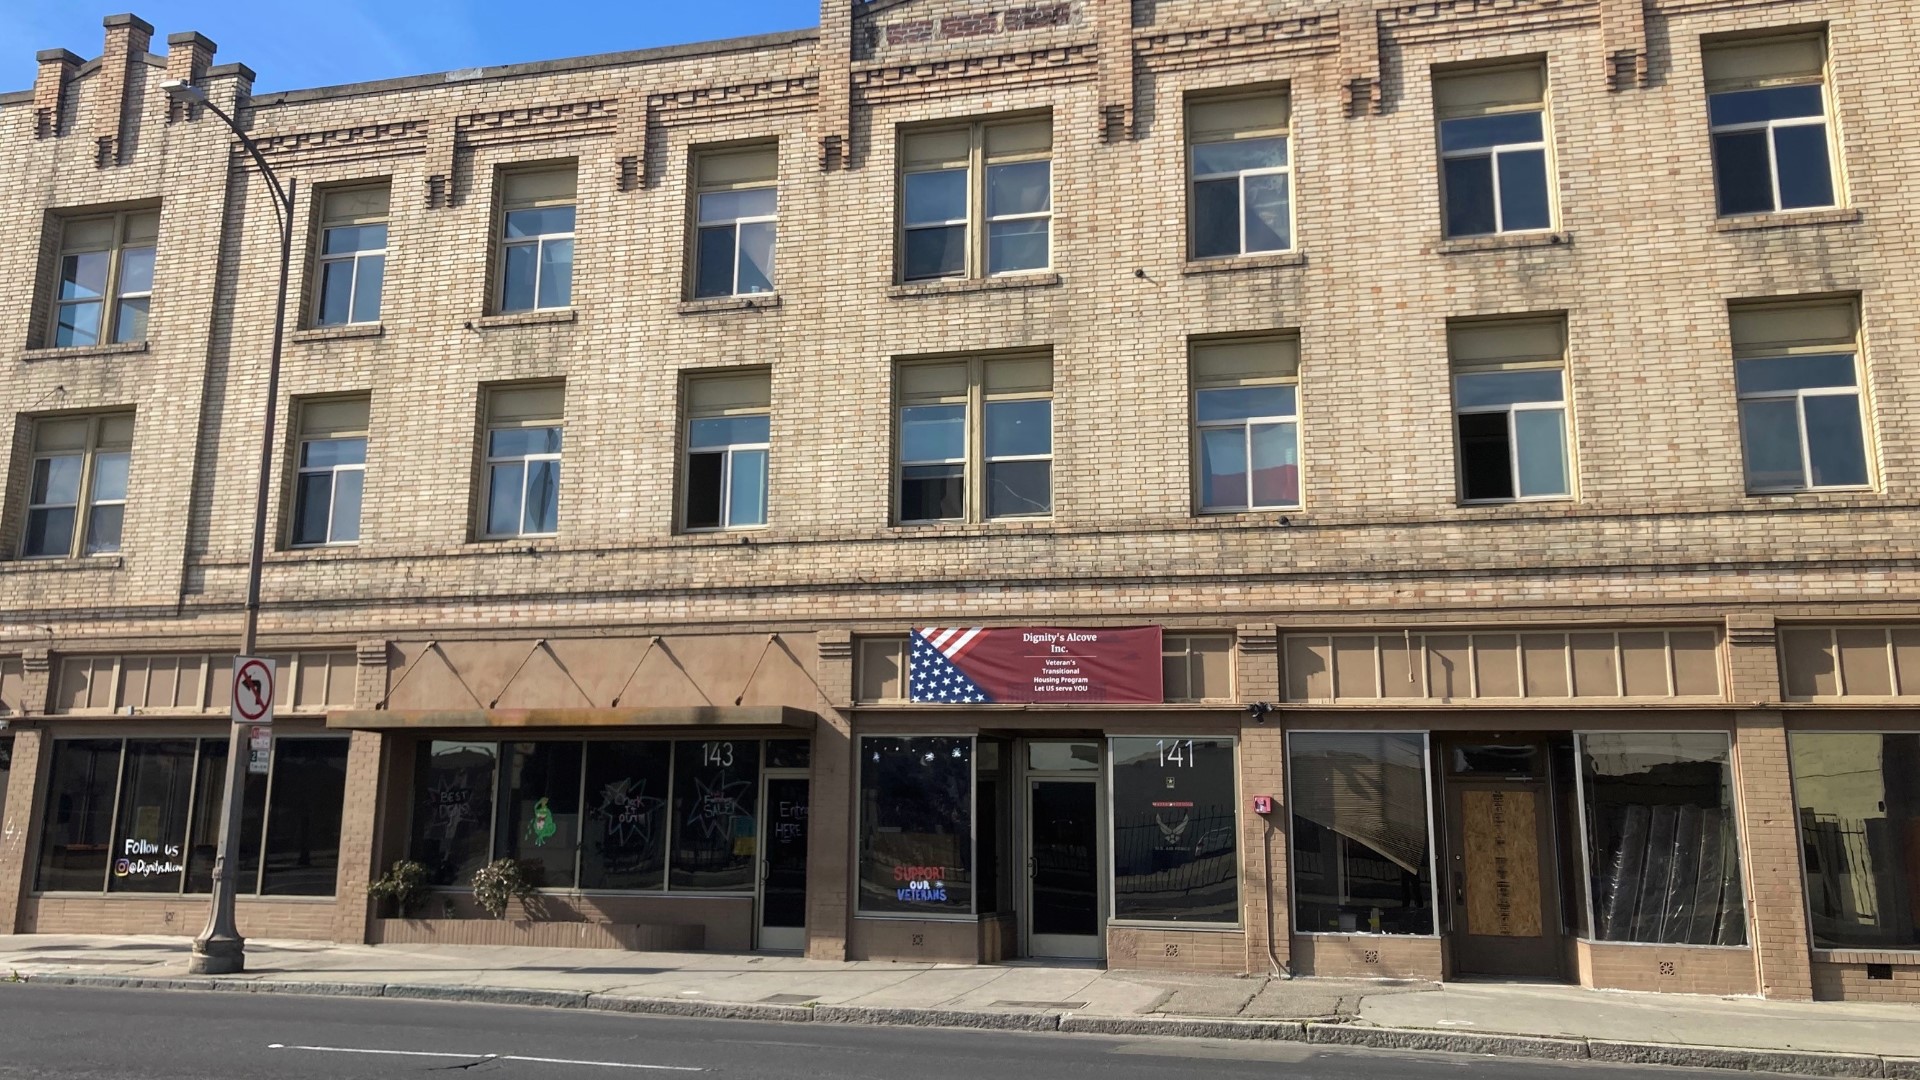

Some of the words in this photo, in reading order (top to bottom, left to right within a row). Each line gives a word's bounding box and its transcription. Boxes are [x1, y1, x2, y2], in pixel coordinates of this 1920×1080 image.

[1023, 633, 1065, 644] Dignity's
[1067, 633, 1097, 642] Alcove
[1051, 645, 1069, 653] Inc.
[702, 742, 734, 767] 143
[1156, 739, 1194, 768] 141
[440, 791, 468, 803] BEST
[775, 822, 803, 839] HERE
[125, 839, 159, 856] Follow
[164, 844, 180, 857] us
[893, 866, 945, 881] SUPPORT
[909, 880, 930, 890] OUR
[897, 888, 947, 901] VETERANS
